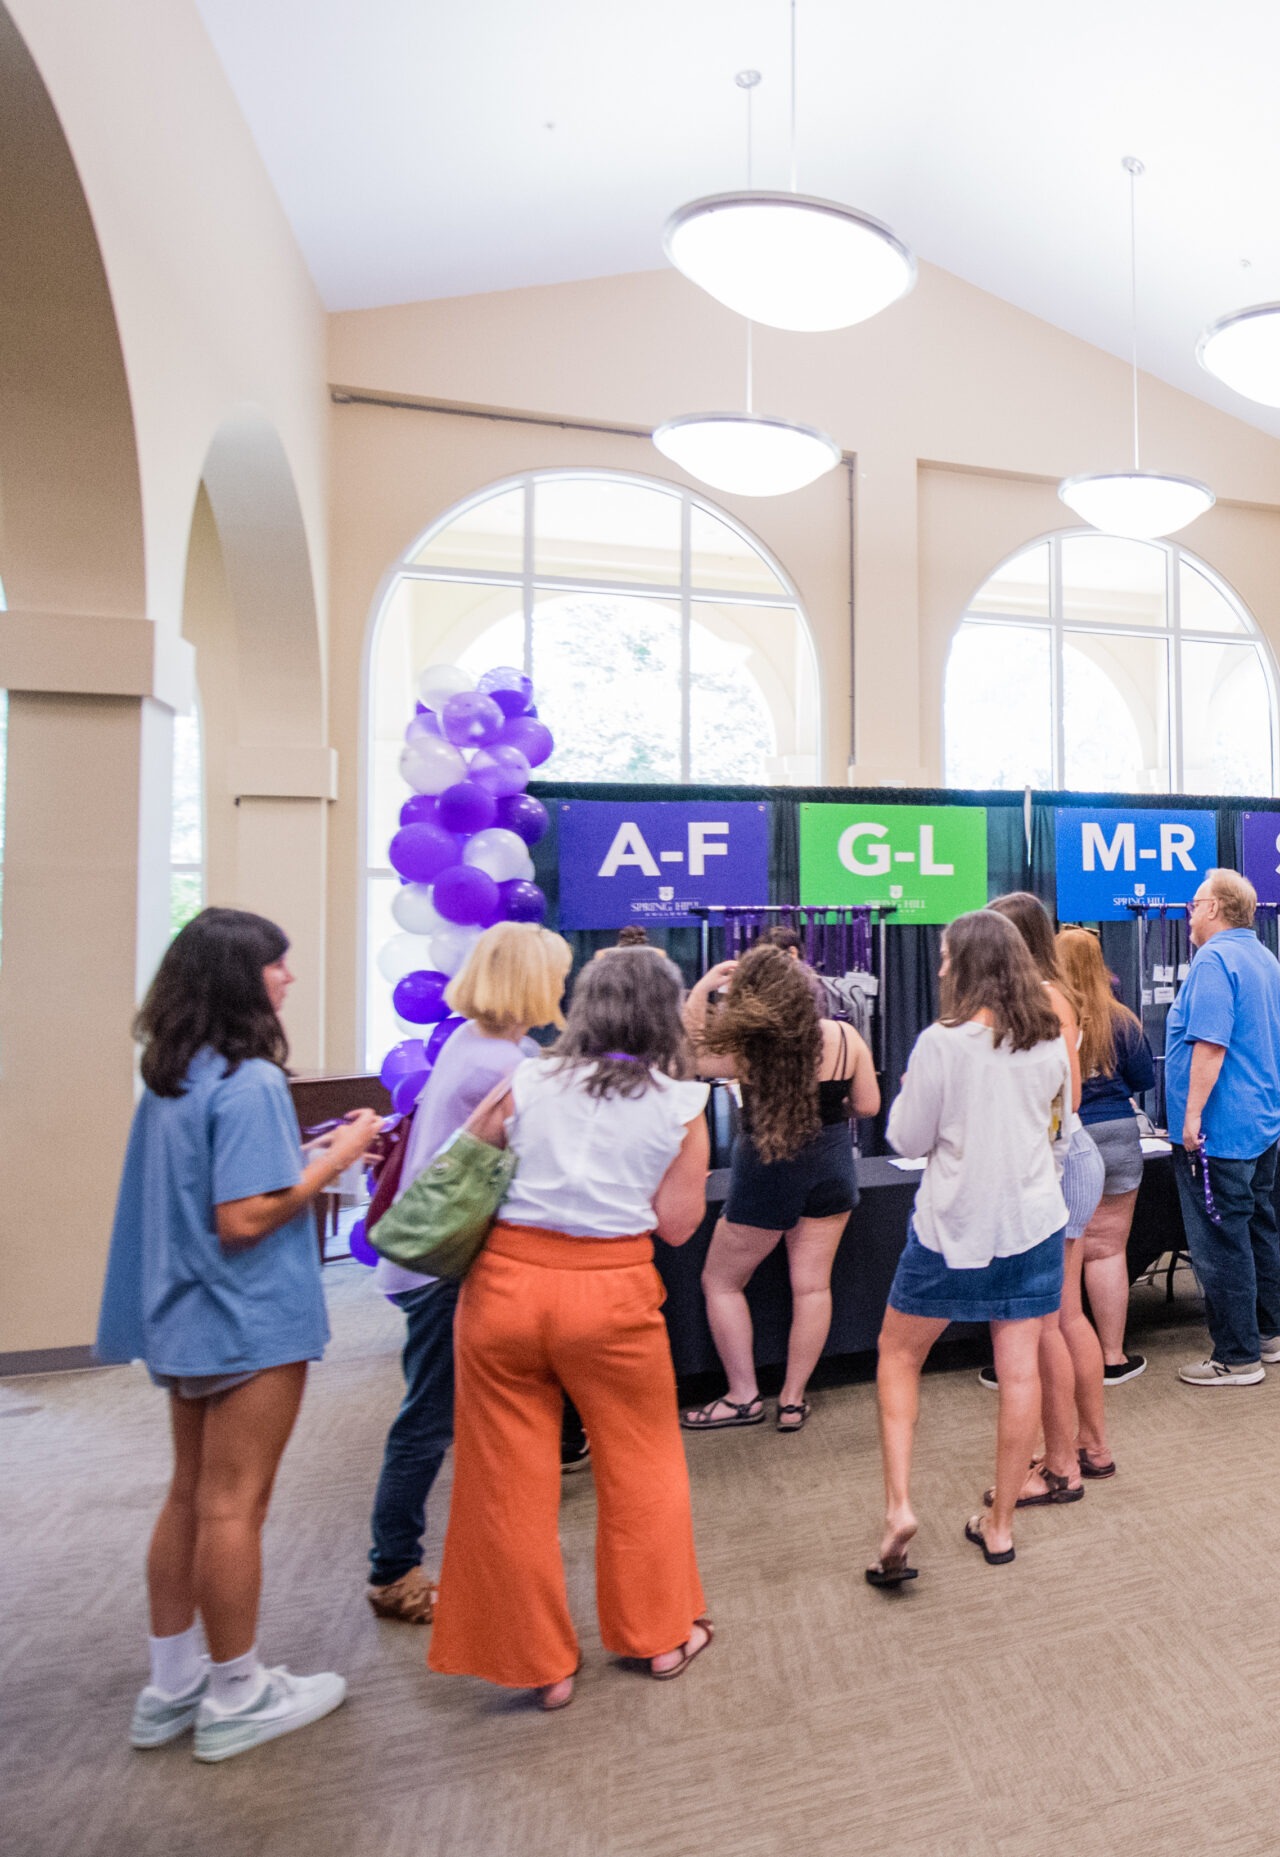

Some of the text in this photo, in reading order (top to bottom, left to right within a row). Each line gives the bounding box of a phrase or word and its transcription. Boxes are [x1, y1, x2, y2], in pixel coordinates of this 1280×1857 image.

[598, 822, 730, 877] A-F
[838, 822, 955, 877] G-L
[1081, 822, 1197, 871] M-R
[630, 901, 673, 912] SPRING
[1112, 897, 1145, 906] SPRING
